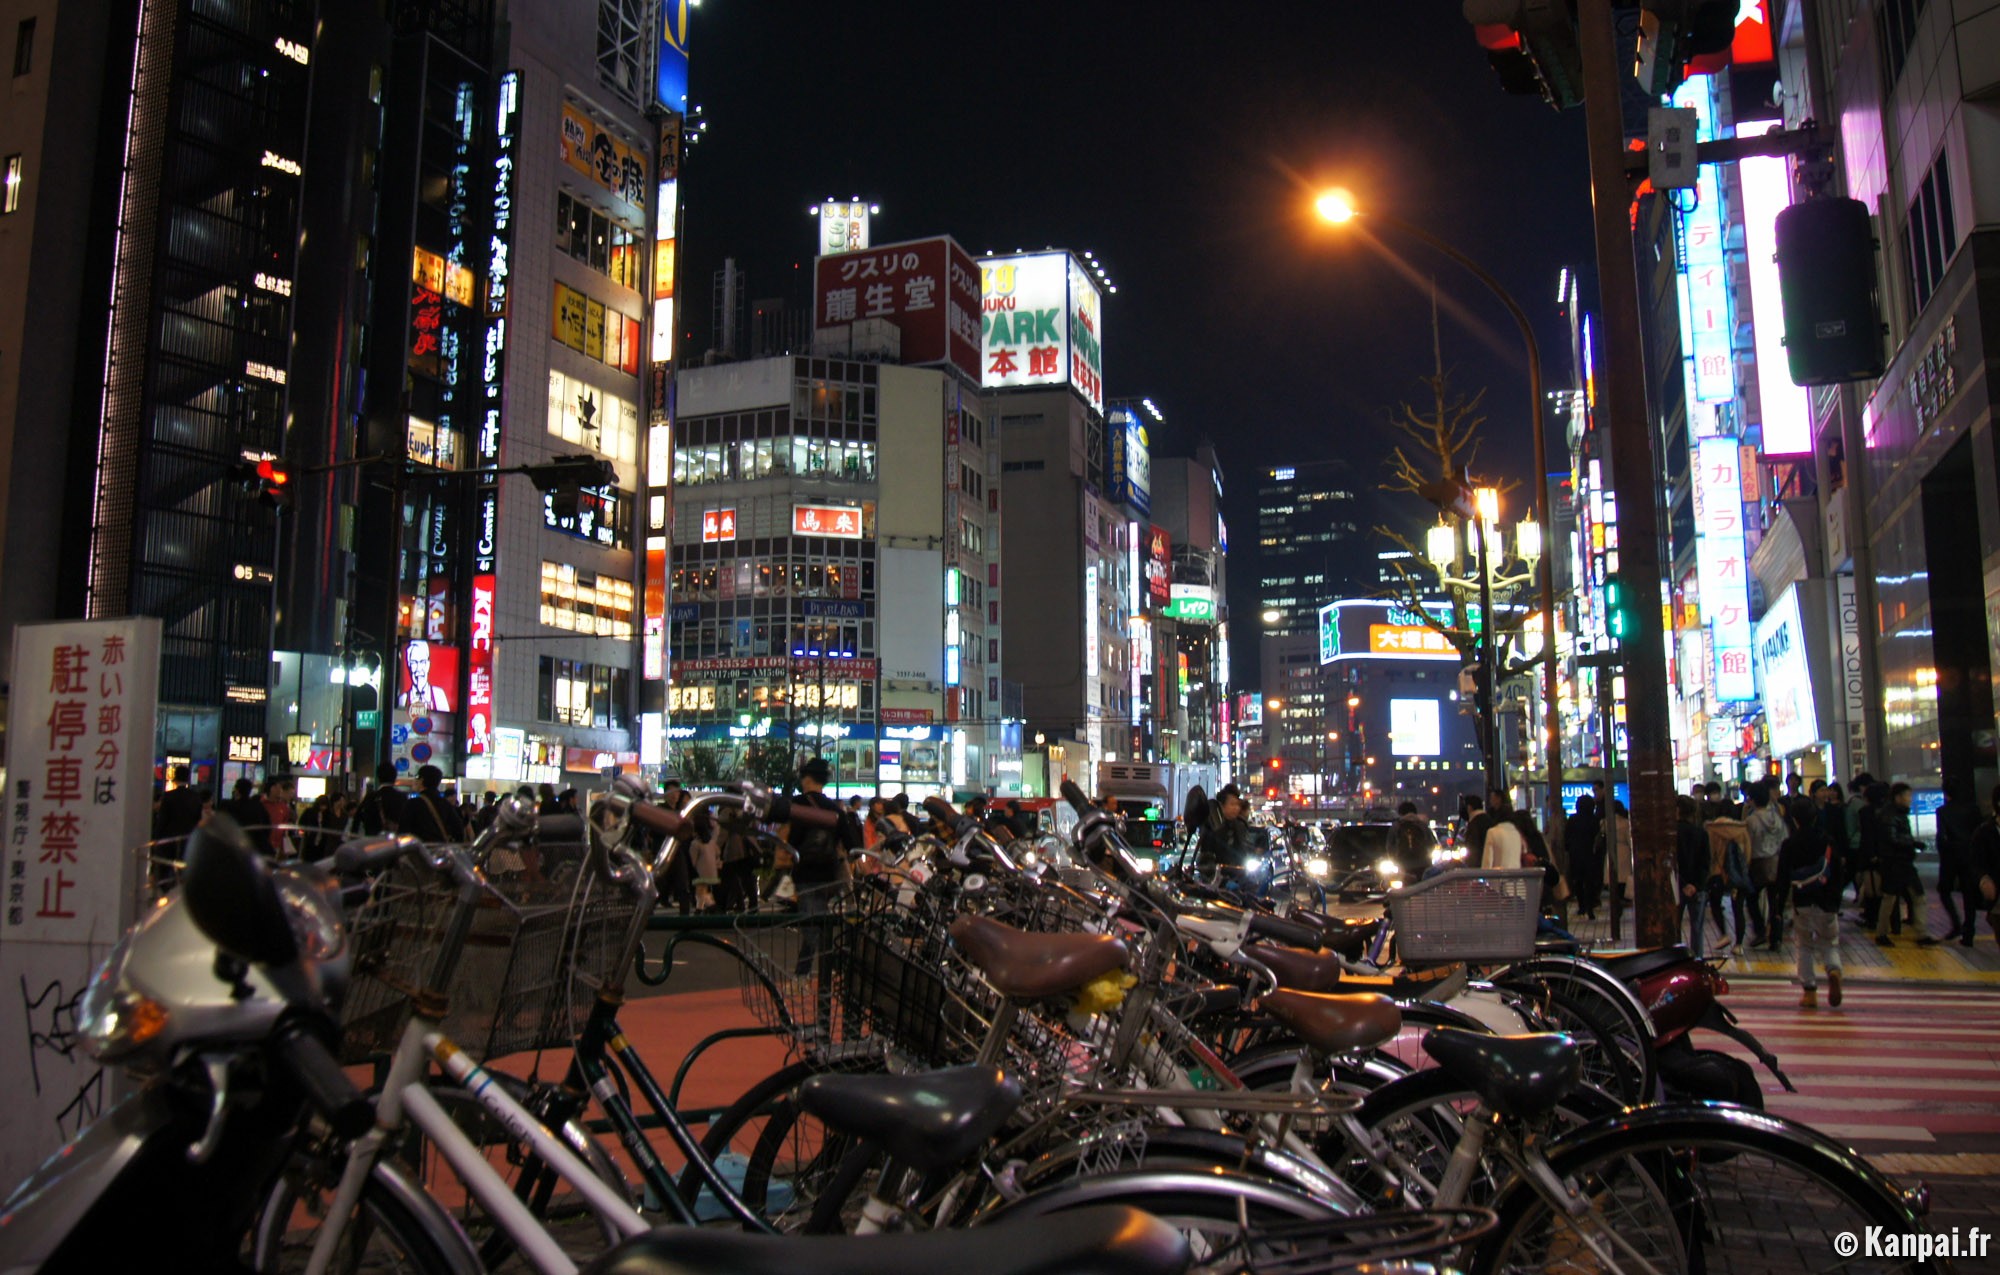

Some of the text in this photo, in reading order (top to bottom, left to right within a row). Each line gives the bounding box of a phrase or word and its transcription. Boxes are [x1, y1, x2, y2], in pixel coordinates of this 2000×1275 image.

[825, 275, 936, 323] 龍生堂
[841, 252, 919, 281] クスリの
[988, 346, 1059, 378] 本館
[1712, 463, 1747, 675] カラオケ館
[473, 587, 491, 653] KFC
[1180, 600, 1208, 615] レイク
[695, 657, 786, 670] 03-3352-1109
[1842, 592, 1864, 710] Hair Salon
[93, 634, 125, 805] 赤い部分は
[36, 644, 90, 920] 駐停車禁止
[8, 779, 30, 926] 警視庁・東京都
